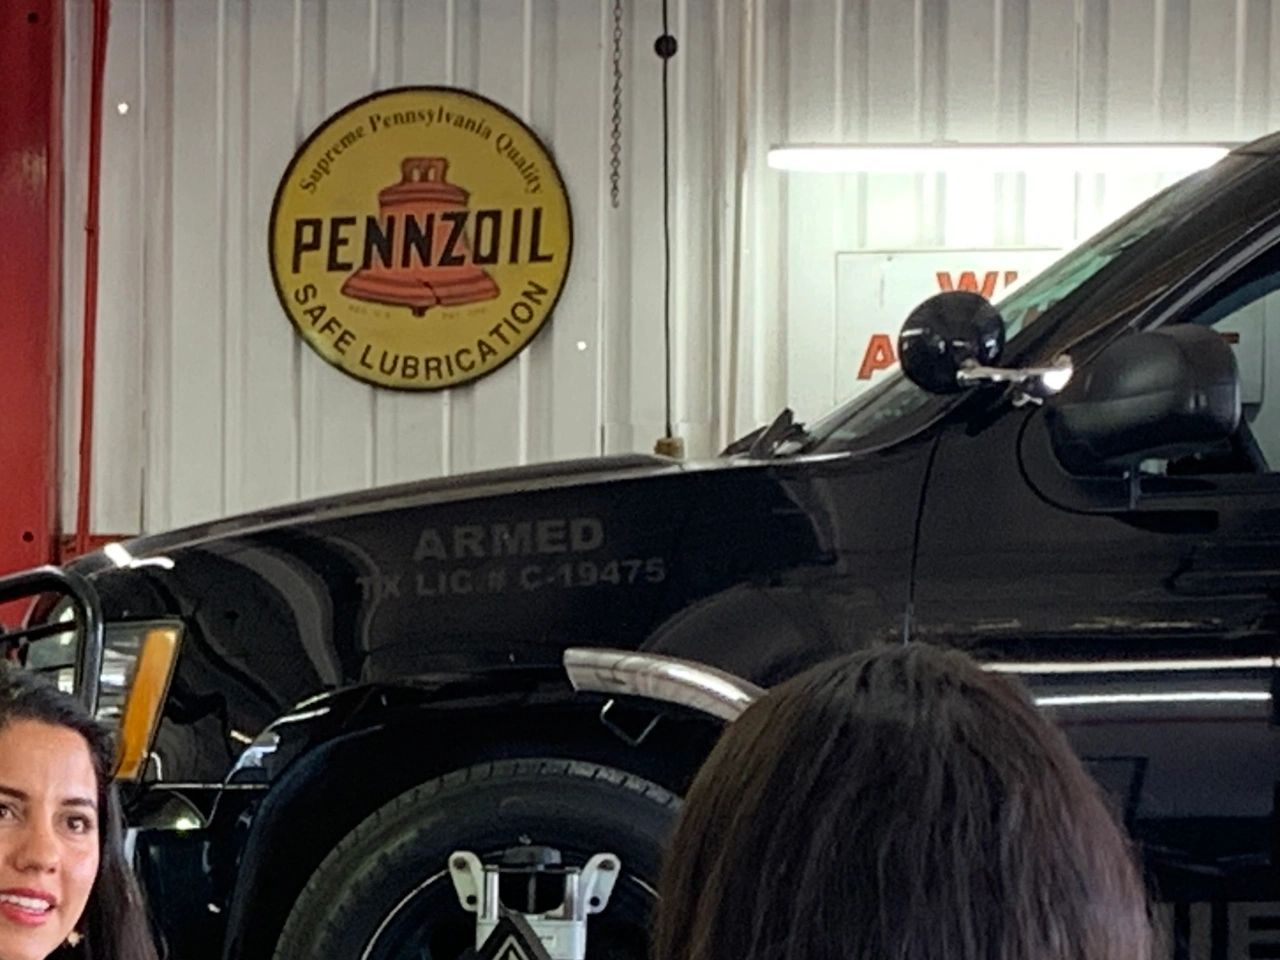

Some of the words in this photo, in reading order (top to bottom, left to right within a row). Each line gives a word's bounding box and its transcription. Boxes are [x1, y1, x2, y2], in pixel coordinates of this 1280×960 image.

[300, 125, 367, 195] Supreme
[368, 106, 493, 141] Pennsylvania
[495, 132, 543, 195] Quality
[292, 207, 554, 274] PENNZOIL
[294, 283, 357, 356] SAFE
[359, 280, 548, 381] LUBRICATION
[413, 517, 605, 560] ARMED
[355, 575, 401, 601] TX
[415, 568, 471, 597] LIC
[519, 557, 667, 592] C-19475
